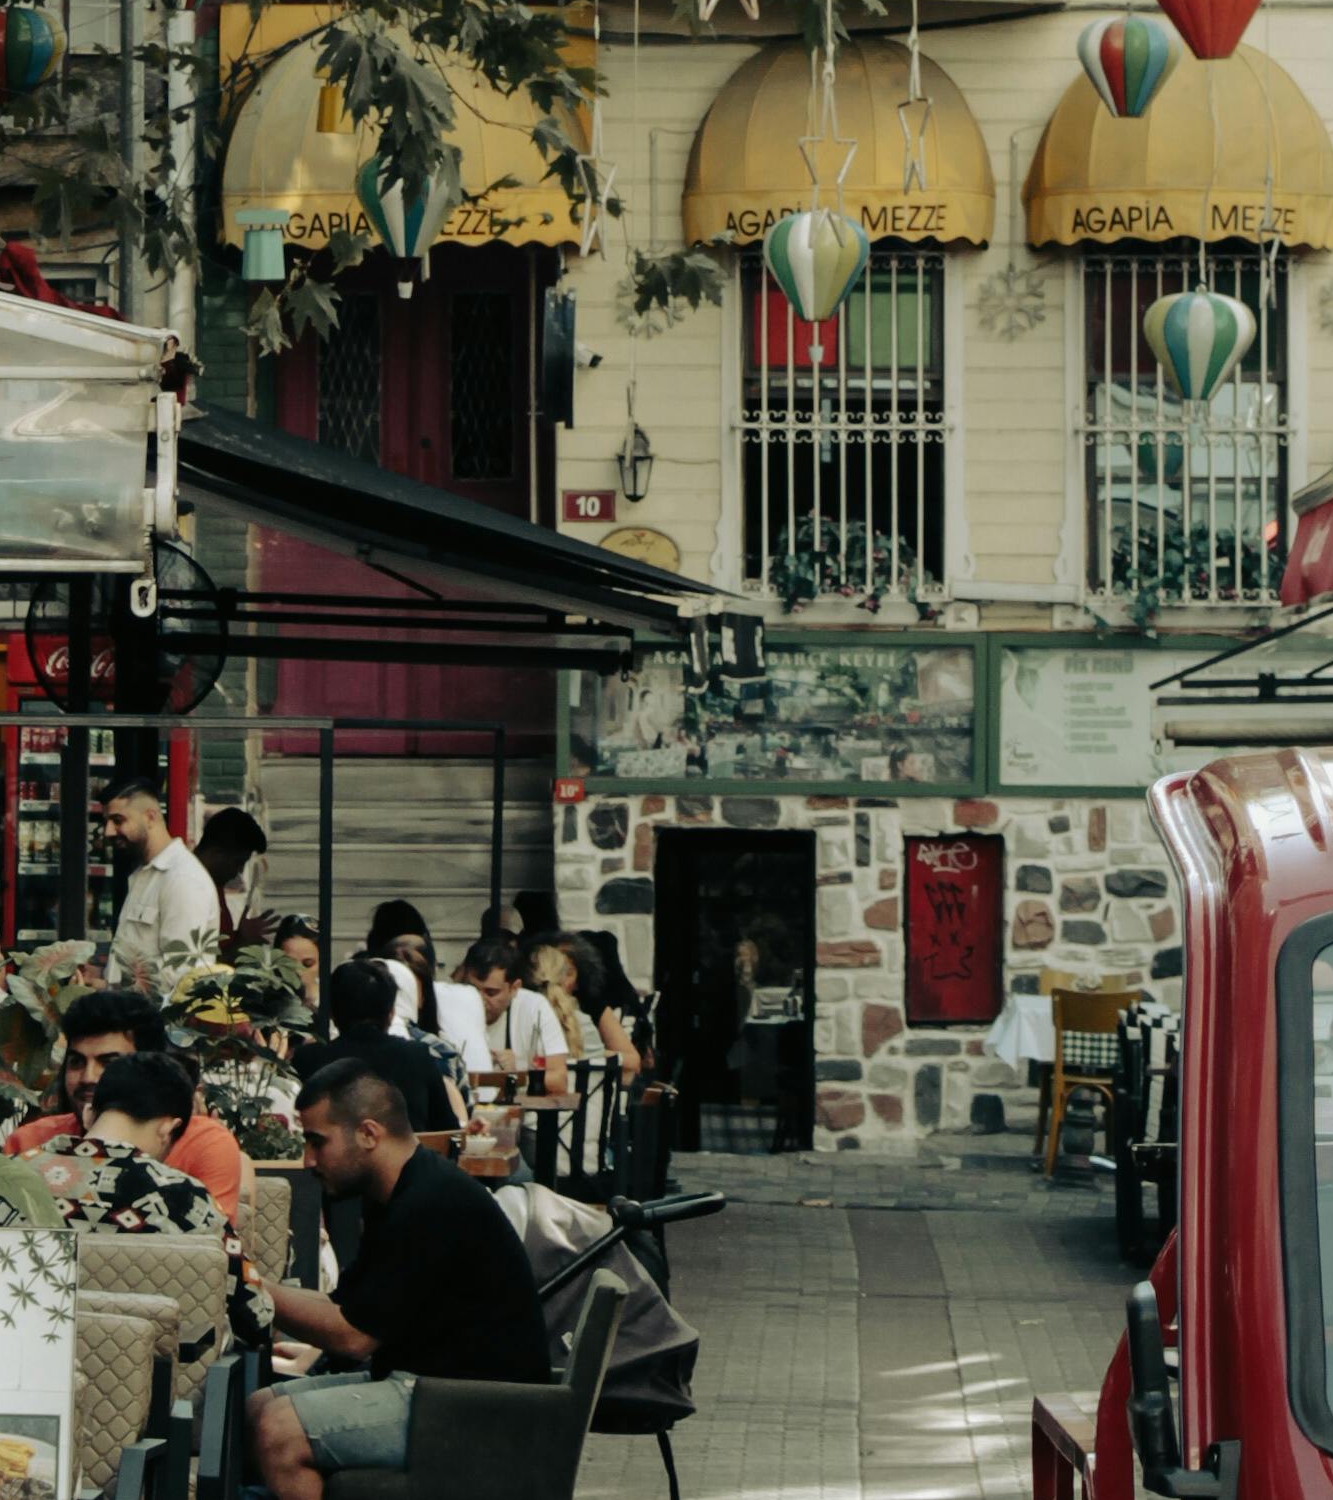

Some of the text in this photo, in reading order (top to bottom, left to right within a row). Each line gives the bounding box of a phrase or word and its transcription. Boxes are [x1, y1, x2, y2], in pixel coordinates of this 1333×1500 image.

[860, 204, 948, 232] MEZZE
[1071, 200, 1174, 234] AGAPİA
[575, 495, 601, 517] 10
